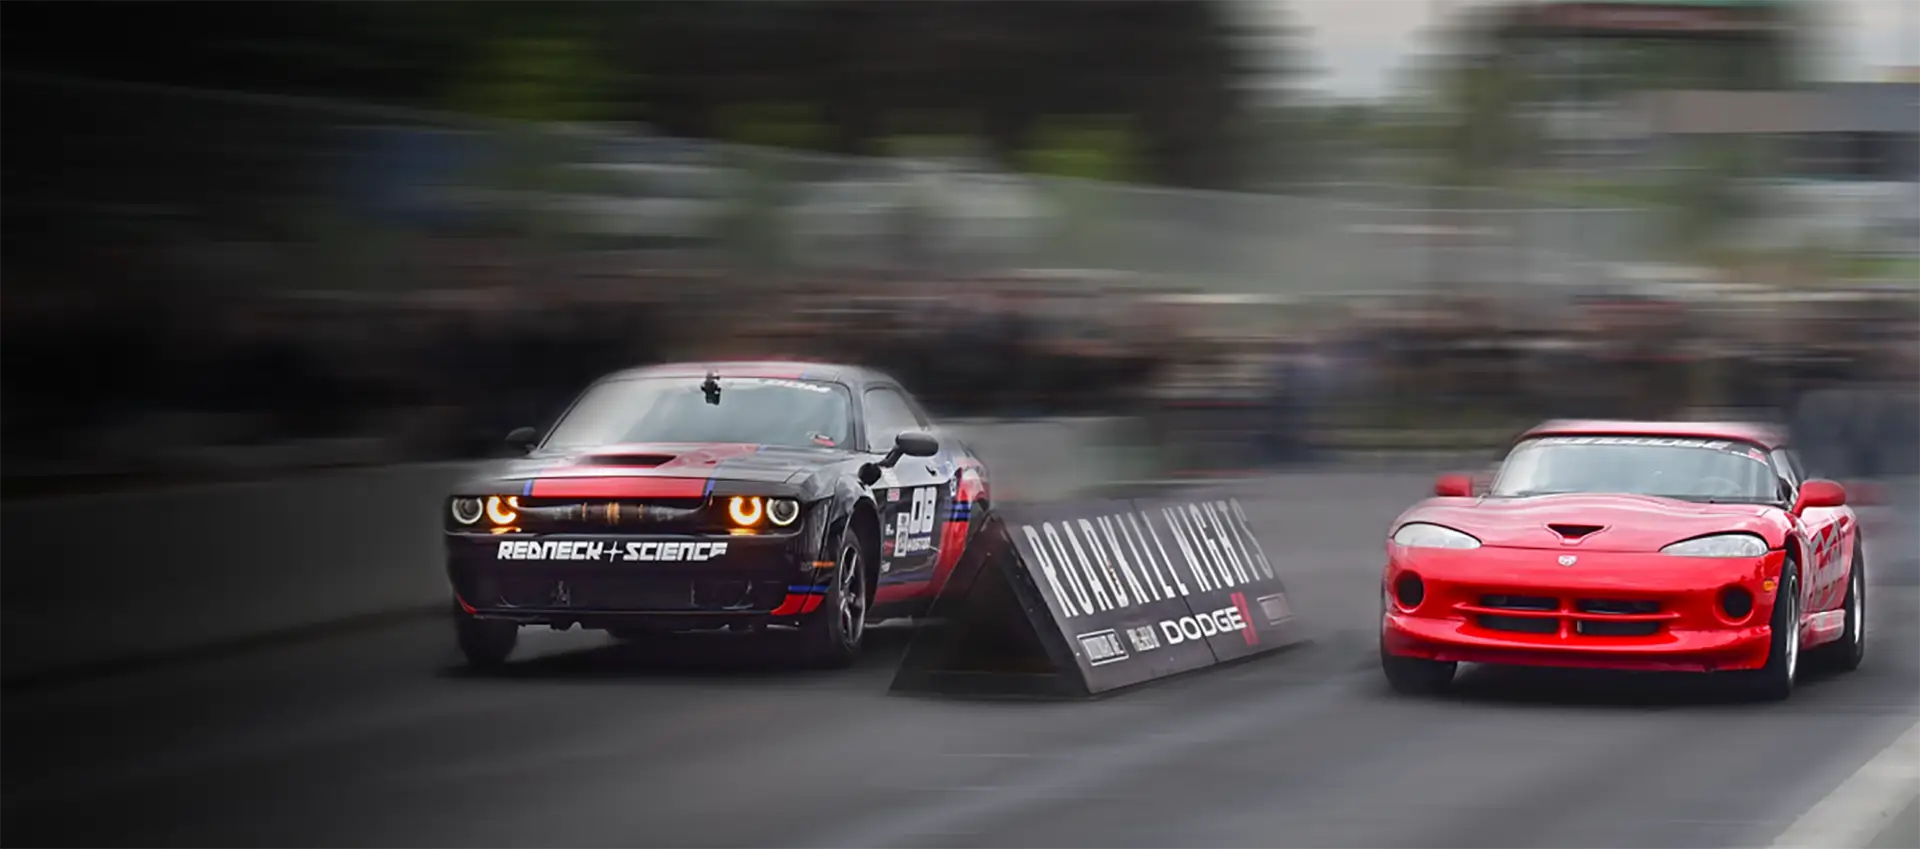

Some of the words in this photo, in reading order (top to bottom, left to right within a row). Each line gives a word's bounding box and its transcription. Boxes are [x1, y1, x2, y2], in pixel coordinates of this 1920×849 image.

[1022, 510, 1189, 618] ROADKILL
[1161, 497, 1274, 592] NIGHTS
[1159, 606, 1247, 645] DODGE
